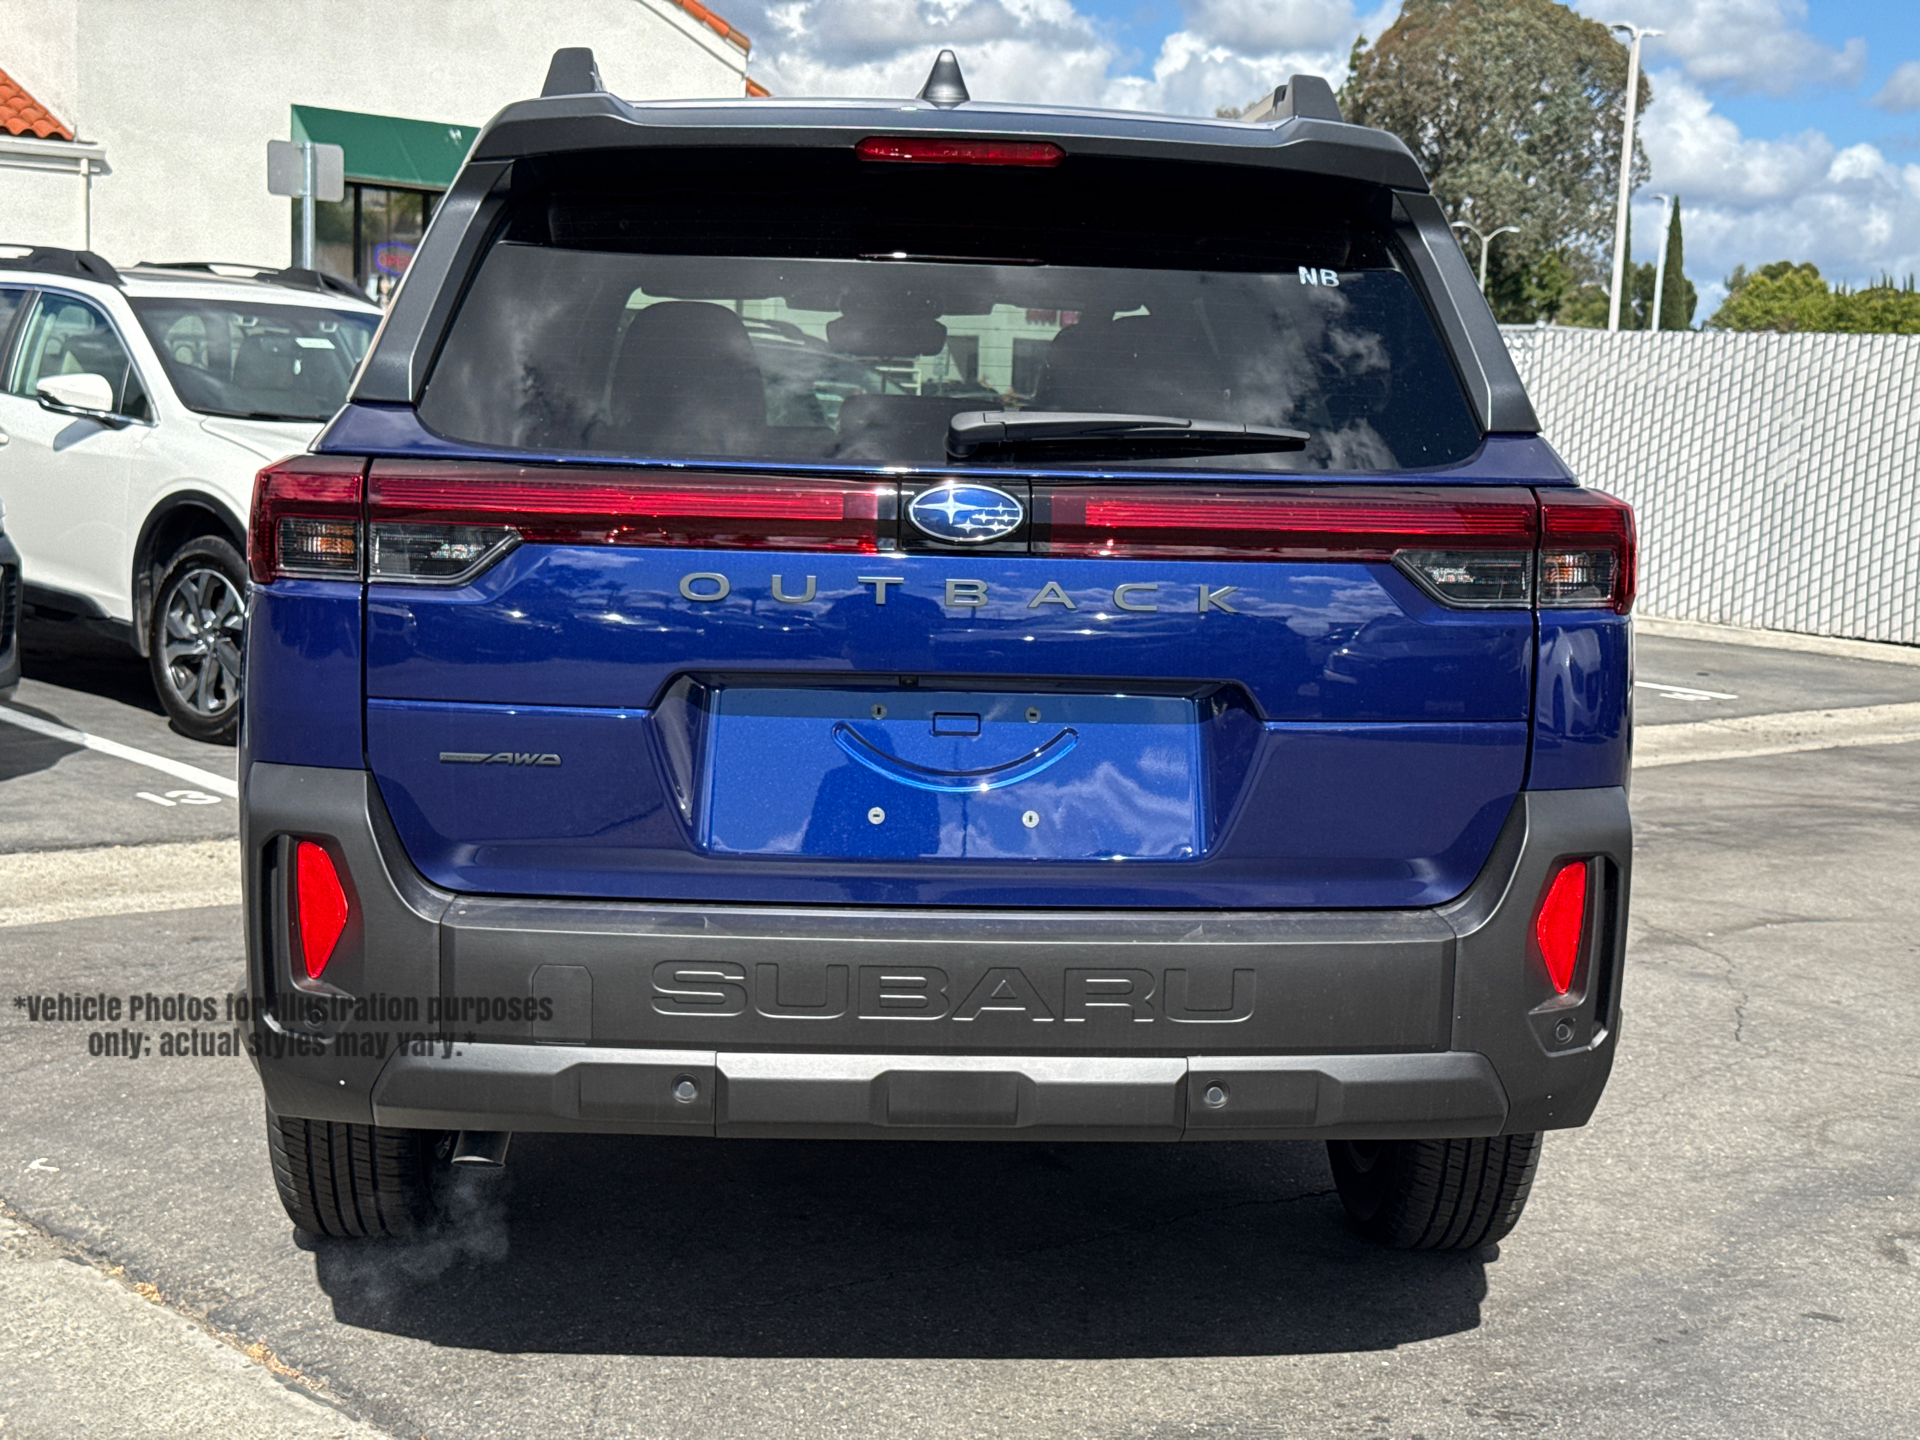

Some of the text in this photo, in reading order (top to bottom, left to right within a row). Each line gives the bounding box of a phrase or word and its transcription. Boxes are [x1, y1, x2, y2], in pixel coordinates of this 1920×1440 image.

[379, 253, 411, 270] OPE
[1298, 265, 1340, 288] NB
[678, 571, 1240, 614] OUTBACK
[485, 752, 562, 766] AWD
[651, 959, 1257, 1024] SUBARU
